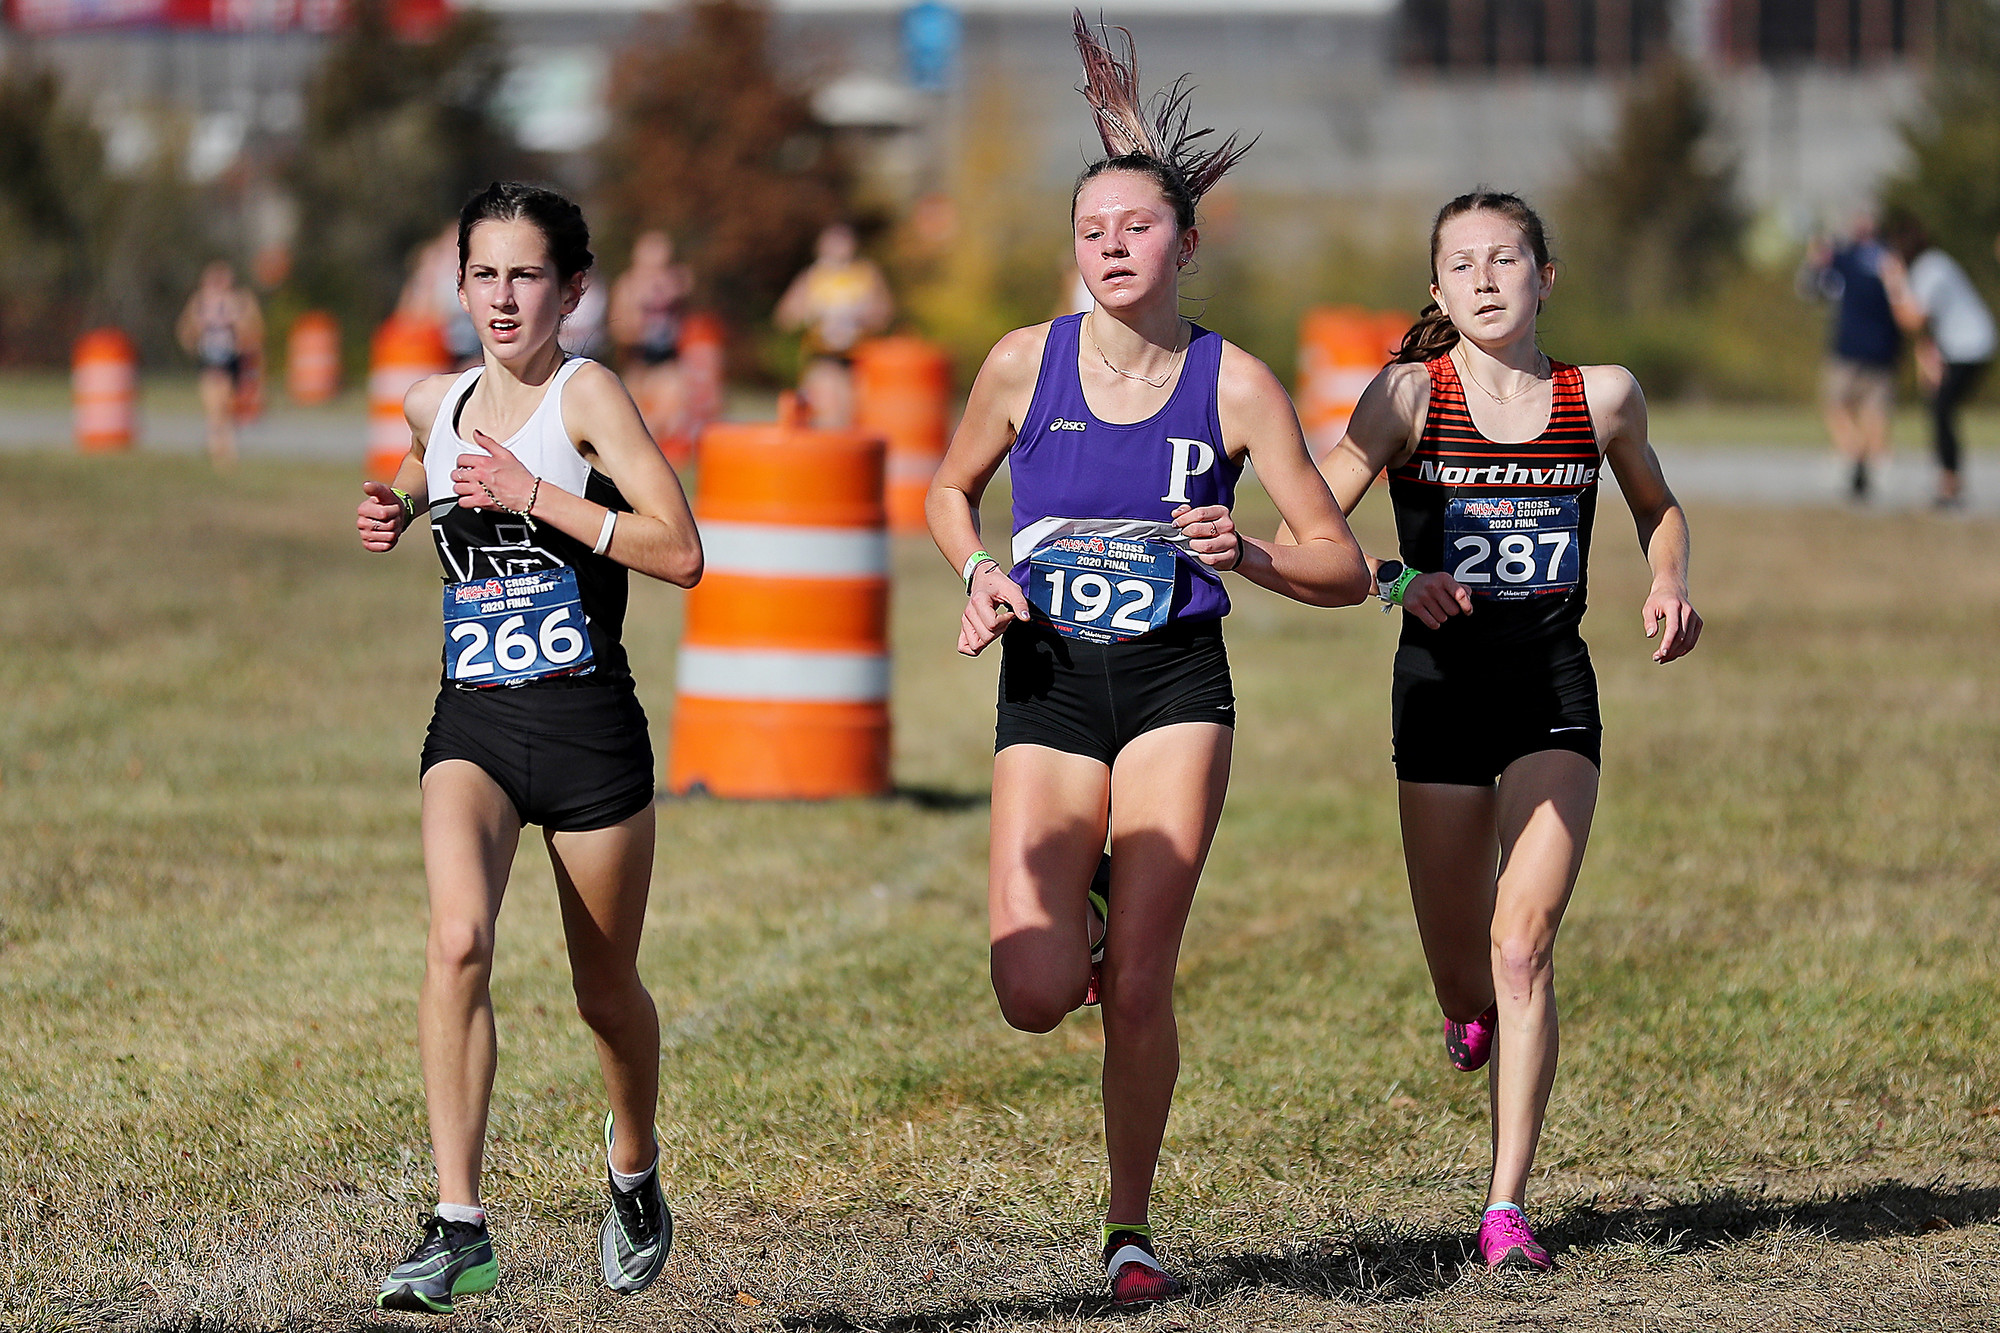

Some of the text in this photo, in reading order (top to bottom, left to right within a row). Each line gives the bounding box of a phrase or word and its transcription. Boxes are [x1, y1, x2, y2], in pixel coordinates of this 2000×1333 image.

[1061, 420, 1087, 431] asics
[1161, 437, 1215, 503] P
[1418, 460, 1596, 485] Northville
[1517, 500, 1550, 510] CROSS
[1517, 507, 1561, 518] COUNTRY
[1488, 518, 1539, 530] 2020 FINAL
[1108, 540, 1145, 554] CROSS
[1076, 555, 1131, 572] 2020 FINAL
[1107, 549, 1156, 564] COUNTRY
[1453, 531, 1571, 583] 287
[504, 575, 541, 588] CROSS
[506, 581, 555, 597] COUNTRY
[480, 600, 505, 614] 2020
[505, 597, 534, 609] FINAL
[1045, 569, 1154, 632] 192
[449, 607, 584, 680] 266
